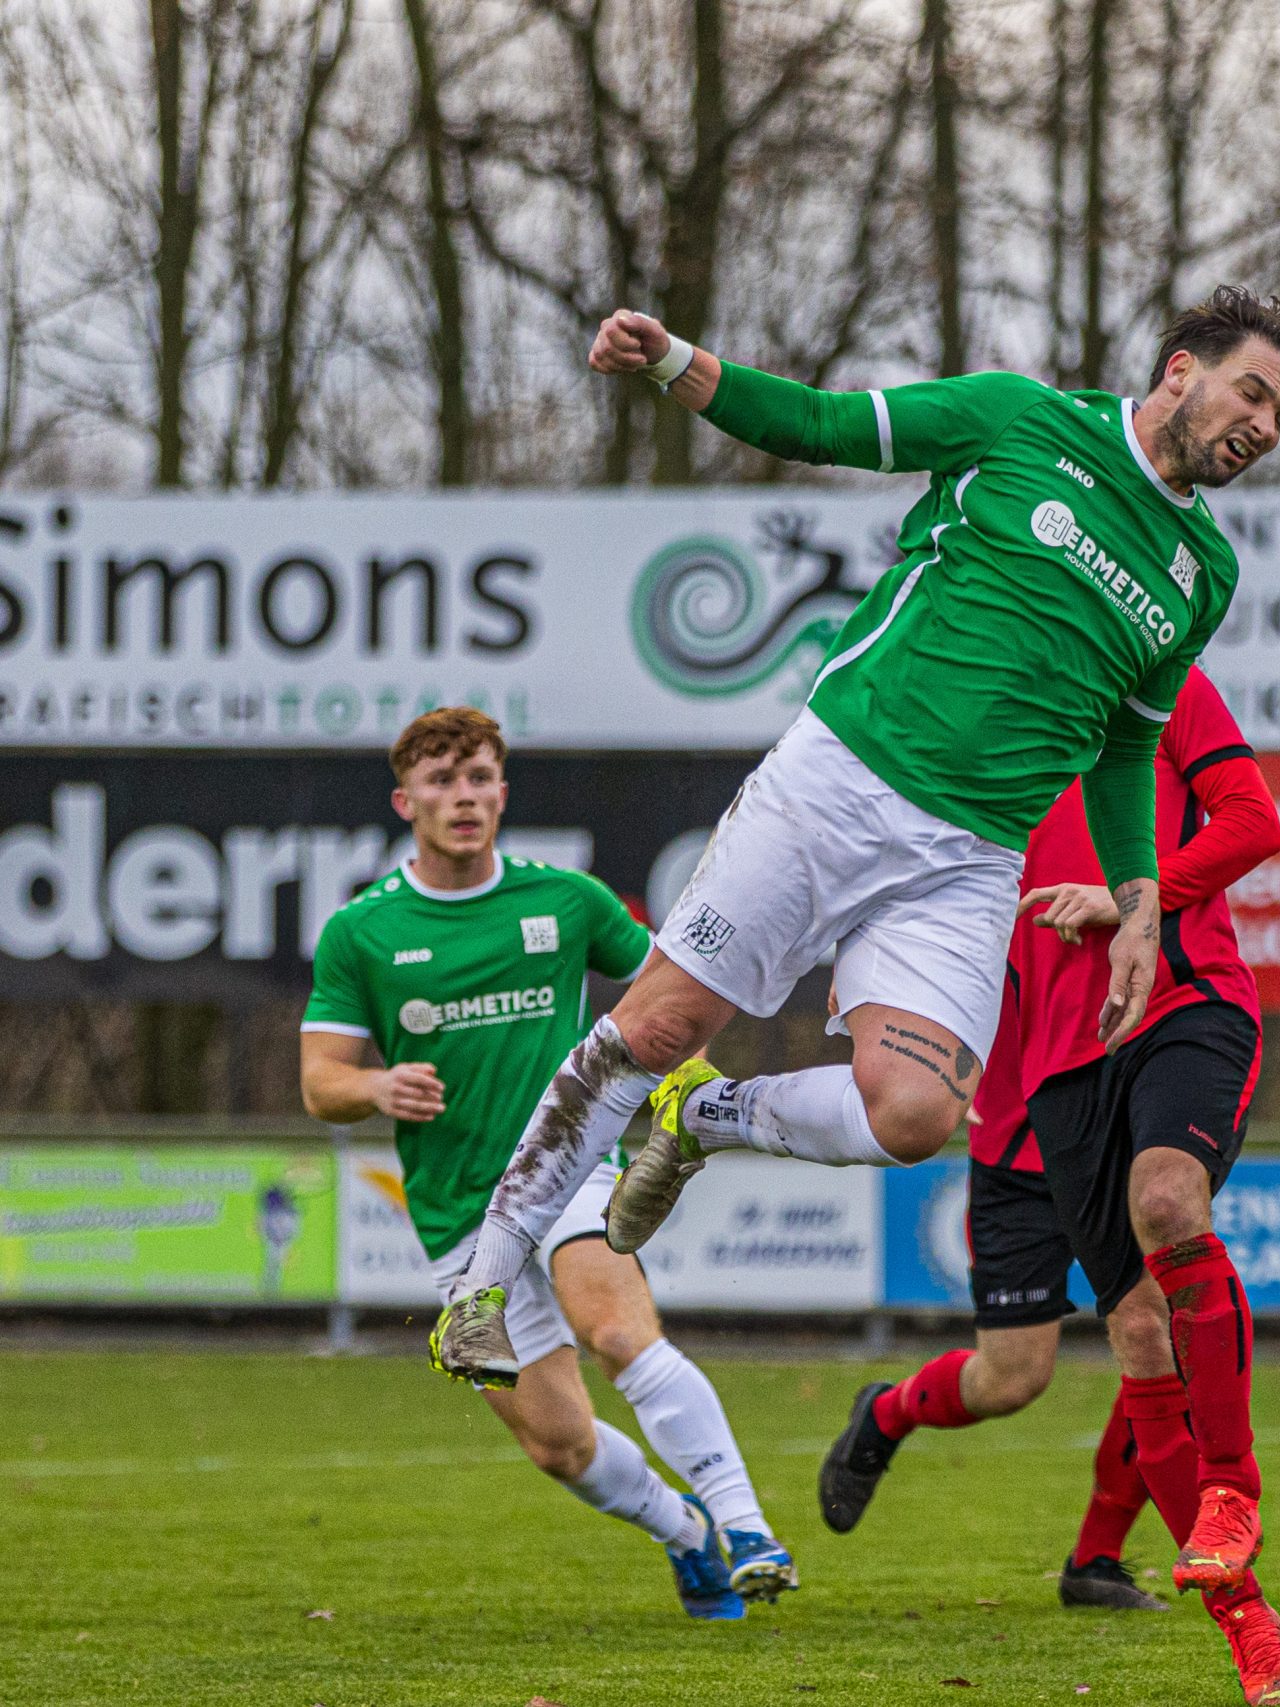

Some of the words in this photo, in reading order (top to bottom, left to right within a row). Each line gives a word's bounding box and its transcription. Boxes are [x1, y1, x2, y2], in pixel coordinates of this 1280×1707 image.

[1055, 456, 1096, 489] JAKO
[1031, 500, 1176, 646] HERMETICO
[1063, 551, 1095, 581] HOUTEN
[1093, 576, 1104, 589] EN
[1102, 586, 1141, 626] KUNSTSTOF
[393, 947, 433, 966] JAKO
[399, 985, 555, 1034] HERMETICO
